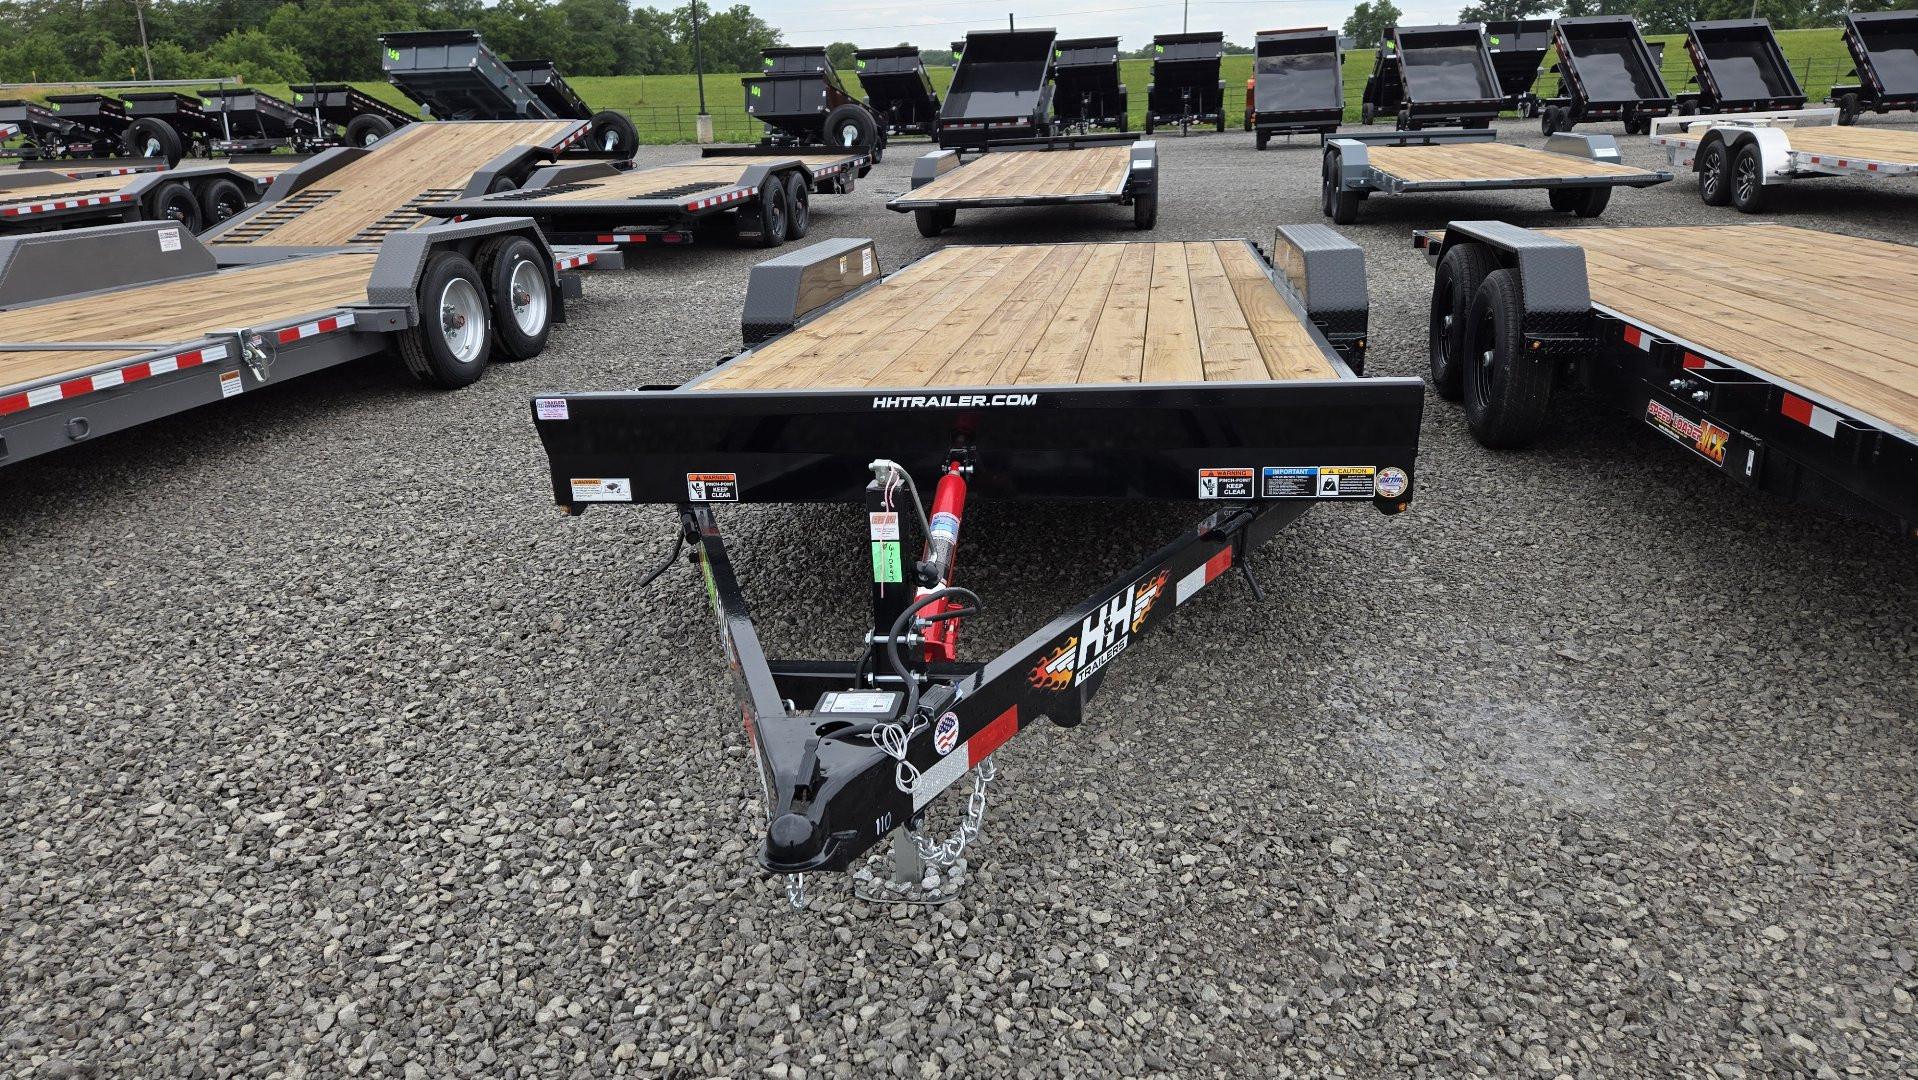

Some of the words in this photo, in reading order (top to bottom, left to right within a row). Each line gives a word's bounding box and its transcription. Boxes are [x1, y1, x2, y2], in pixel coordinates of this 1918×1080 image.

[872, 394, 1038, 409] HHTRAILER.COM
[1647, 401, 1673, 425] SPEED
[1672, 412, 1703, 443] LOADER
[1695, 419, 1729, 463] MX
[1077, 583, 1135, 670] H&H
[1078, 642, 1125, 681] TRAILERS
